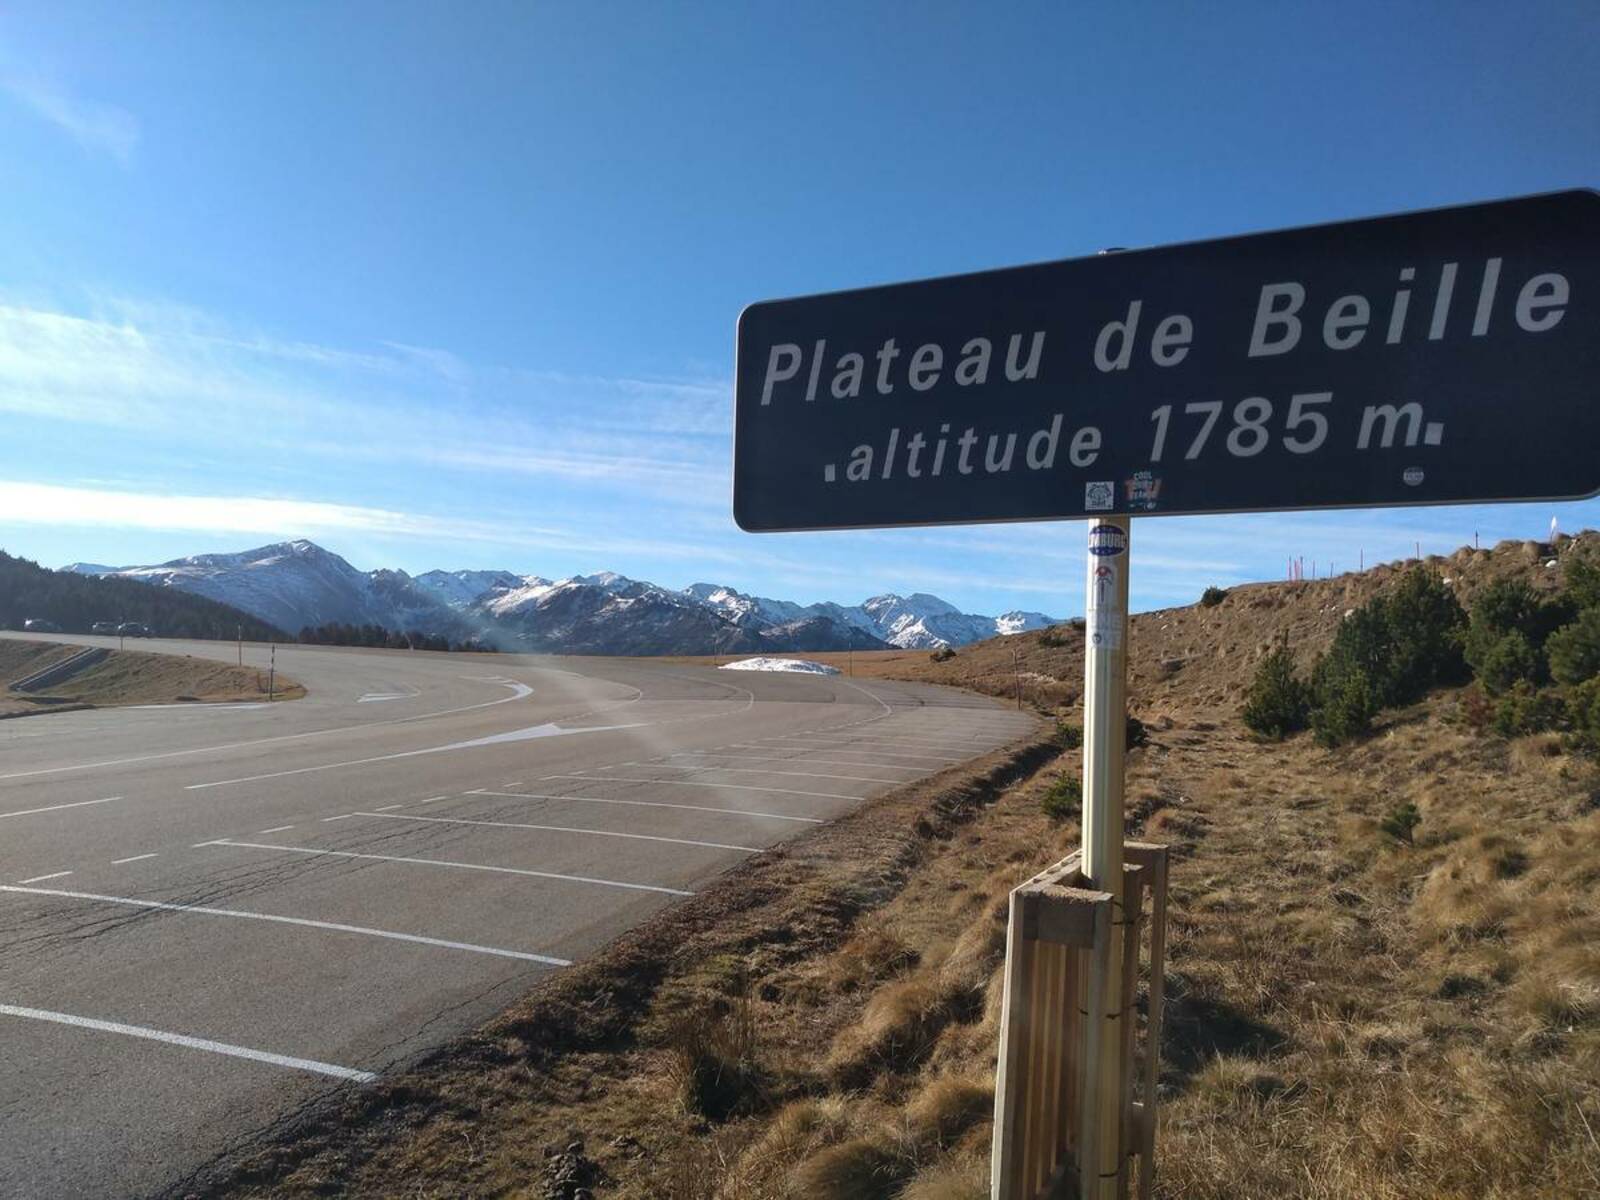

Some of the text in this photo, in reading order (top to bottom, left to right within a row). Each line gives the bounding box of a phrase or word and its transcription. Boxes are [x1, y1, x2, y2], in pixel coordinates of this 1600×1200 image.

[761, 257, 1570, 407] Plateau de Beille
[1150, 391, 1333, 462] 1785
